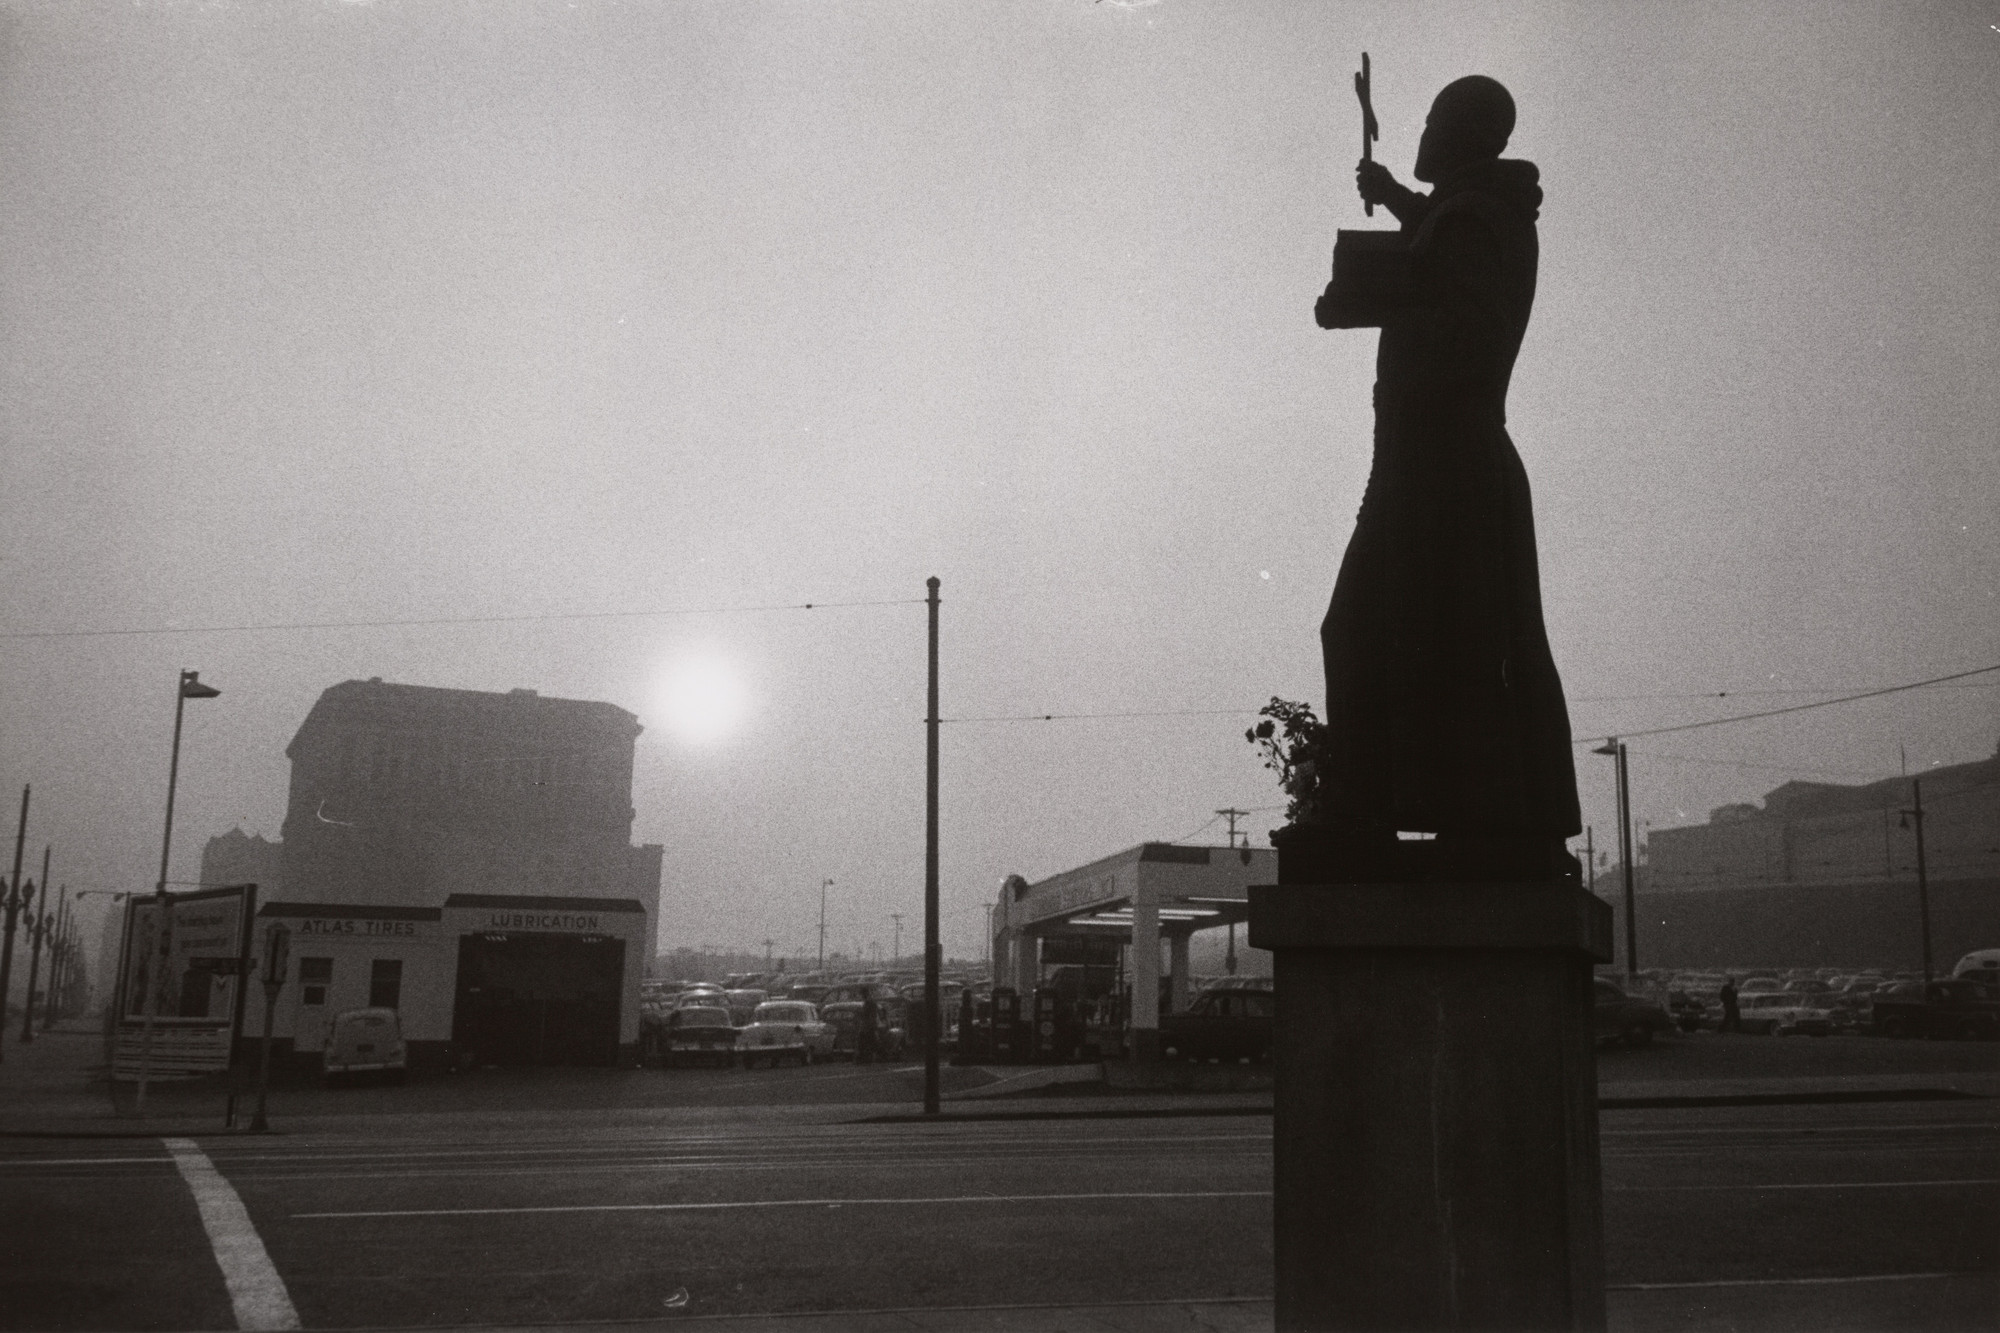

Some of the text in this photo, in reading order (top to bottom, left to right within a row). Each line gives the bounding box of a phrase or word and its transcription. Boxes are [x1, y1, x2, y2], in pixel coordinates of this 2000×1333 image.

[301, 919, 415, 936] ATLAS TIRES
[491, 913, 599, 929] LUBRICATION
